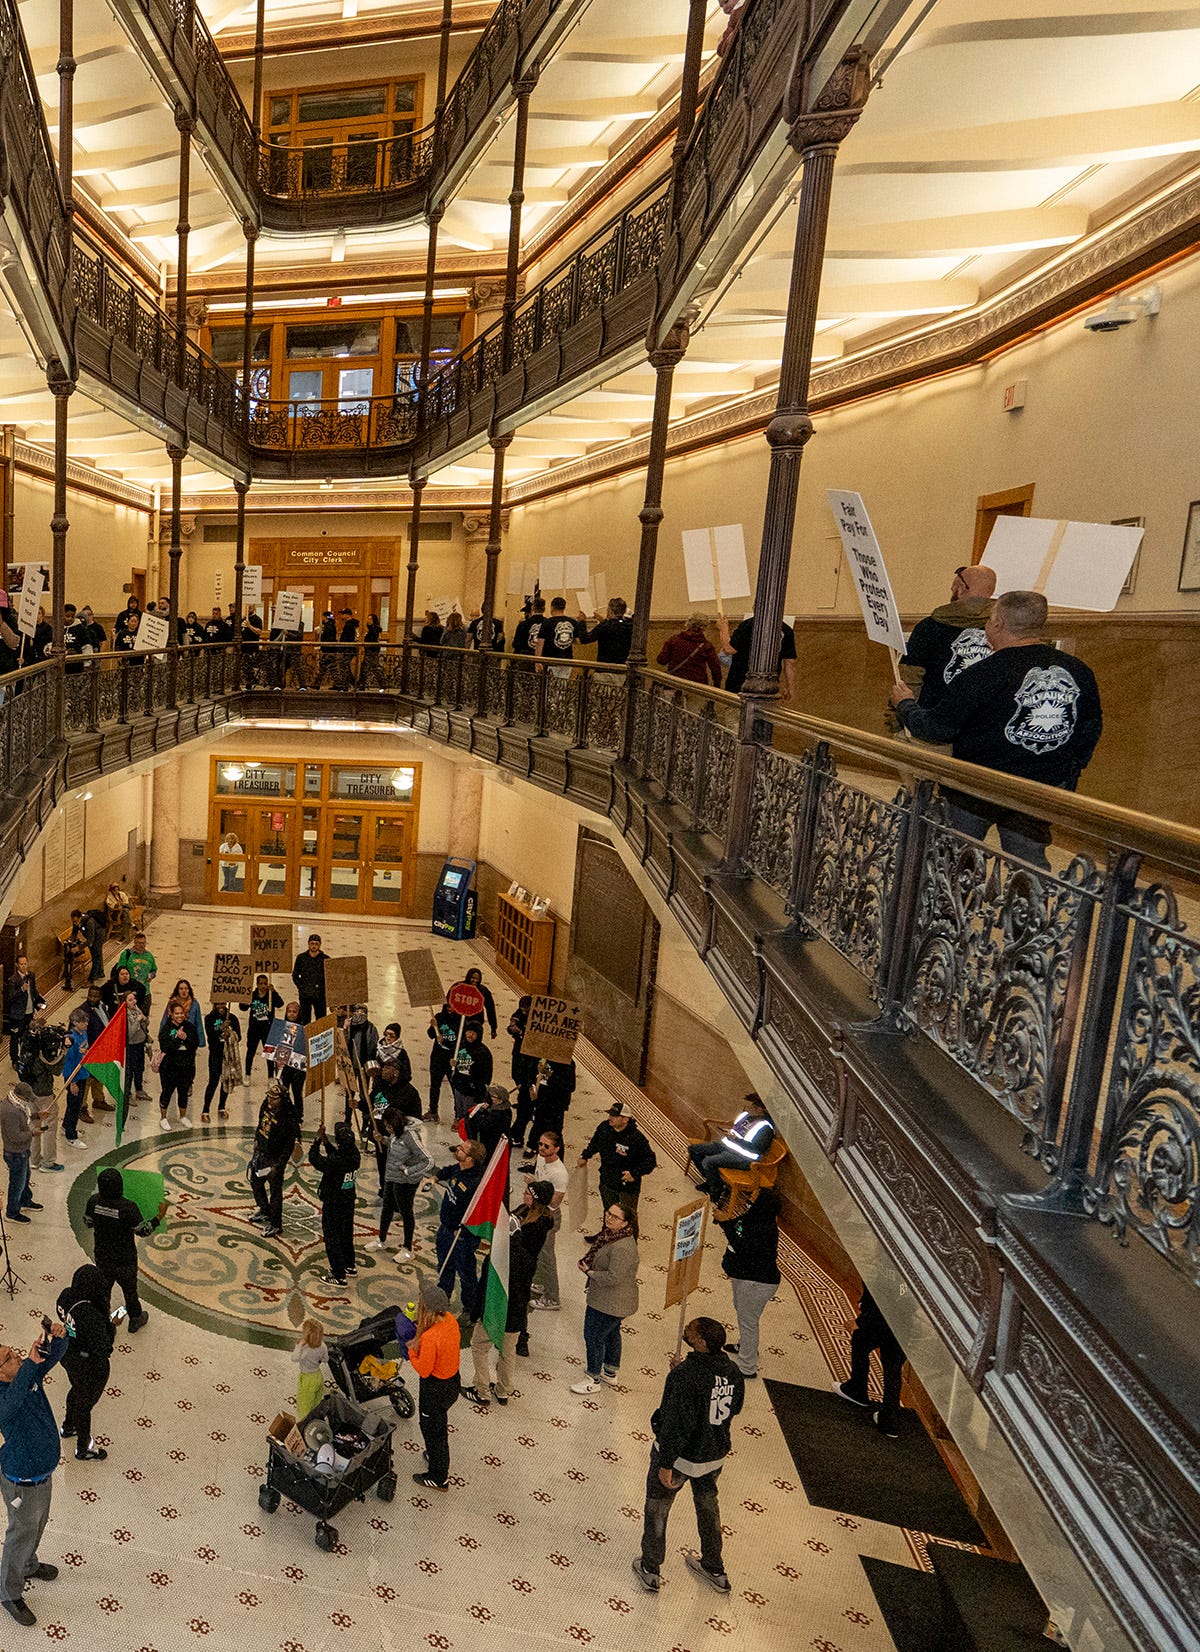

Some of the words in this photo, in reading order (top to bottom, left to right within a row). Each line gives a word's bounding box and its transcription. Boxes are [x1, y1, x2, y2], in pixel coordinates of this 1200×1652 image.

[841, 501, 856, 518] Fair
[840, 518, 855, 536] Pay
[854, 521, 868, 537] For
[852, 547, 877, 567] Those
[860, 565, 879, 583] Who
[859, 578, 888, 600] Protect
[866, 595, 888, 618] Every
[873, 612, 889, 632] Day
[245, 769, 266, 779] CITY
[360, 773, 382, 784] CITY
[233, 780, 280, 791] TREASURER
[346, 783, 396, 796] TREASURER
[252, 927, 266, 938] NO
[253, 939, 287, 951] MONEY
[216, 954, 240, 965] MPA
[242, 965, 252, 976] 21
[255, 961, 279, 973] MPD
[213, 985, 252, 995] DEMANDS
[454, 993, 478, 1006] STOP
[535, 997, 567, 1013] MPD
[531, 1010, 558, 1025] MPA
[560, 1017, 582, 1030] ARE
[530, 1021, 579, 1040] FAILURES
